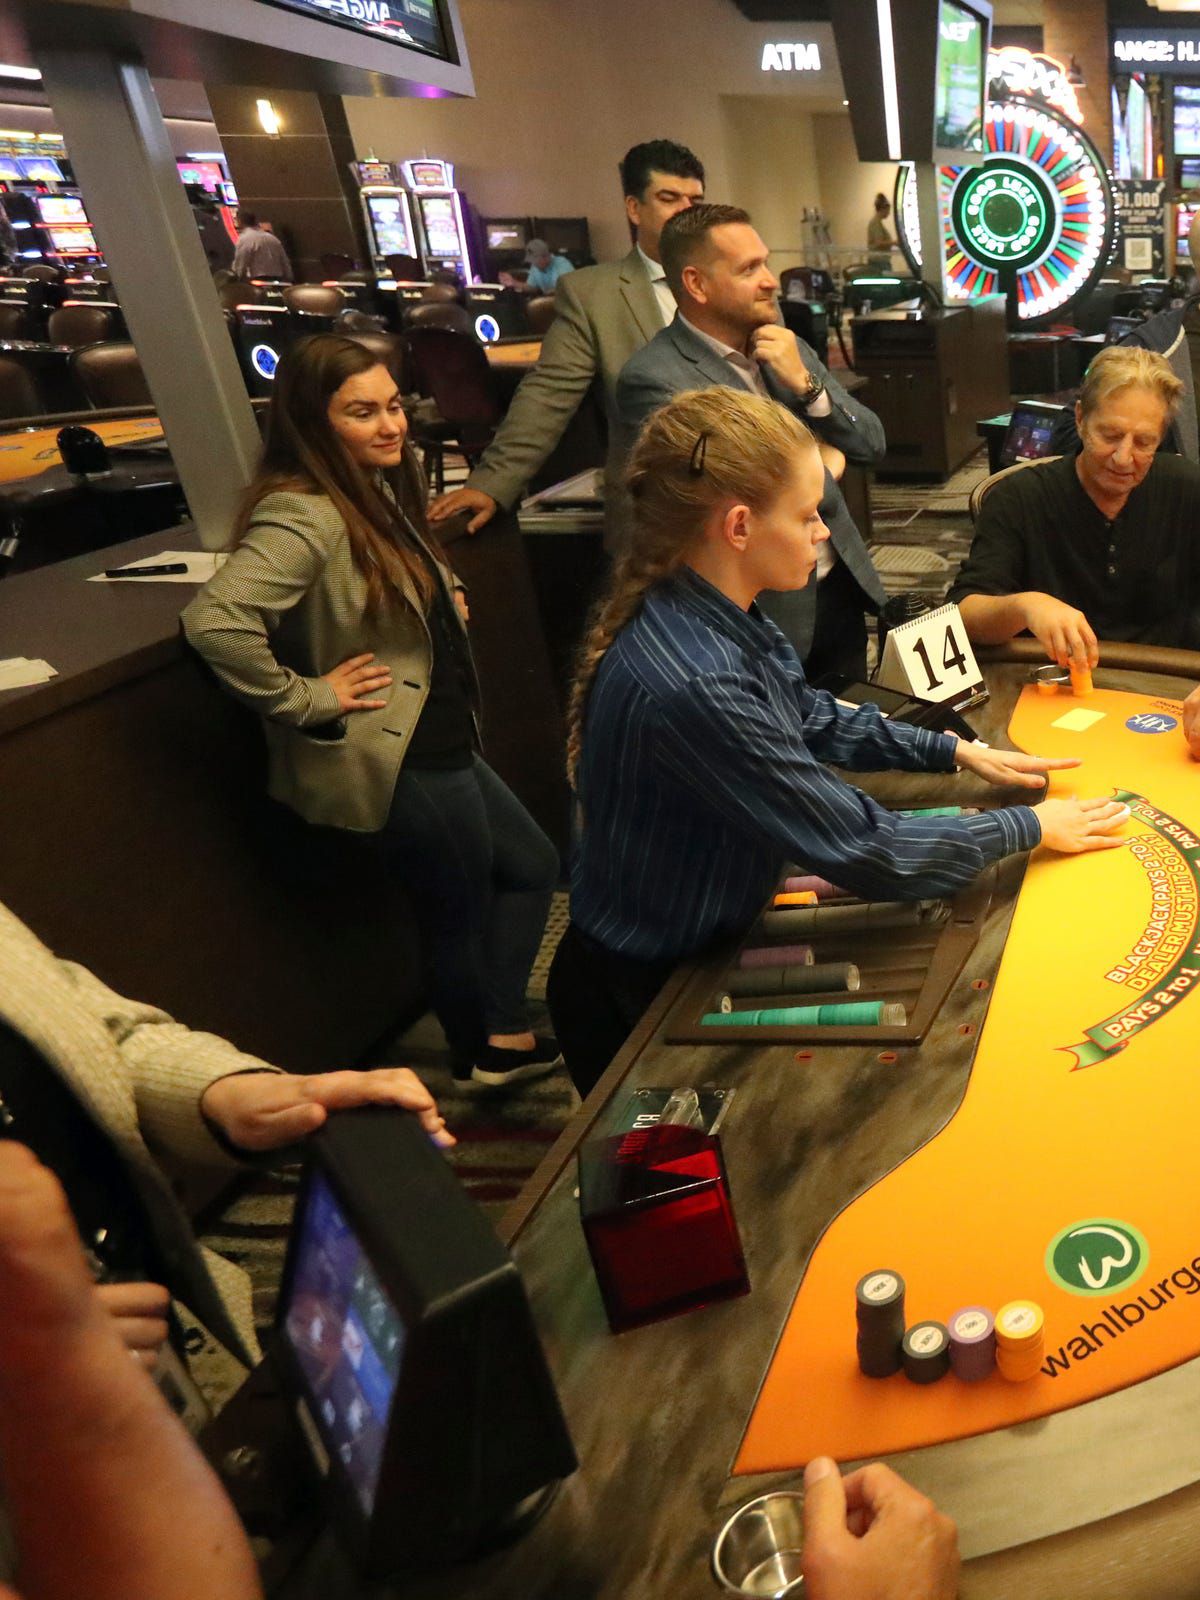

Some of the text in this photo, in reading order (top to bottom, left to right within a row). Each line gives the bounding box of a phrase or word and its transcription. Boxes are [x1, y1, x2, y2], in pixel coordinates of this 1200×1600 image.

[761, 43, 821, 71] ATM
[967, 176, 1037, 215] GOOD LUCK
[970, 215, 1040, 253] GOOD LUCK
[912, 624, 968, 692] 14
[1140, 808, 1161, 823] TO
[1154, 817, 1171, 827] 2
[1129, 843, 1154, 862] TO
[1164, 823, 1200, 850] PAYS
[1143, 859, 1163, 870] 2
[1148, 869, 1172, 902] PAYS
[1125, 833, 1195, 991] DEALER MUST HIT SOFT 17
[1104, 902, 1171, 983] BLACKJACK
[1103, 967, 1200, 1039] PAYS 2 TO 1
